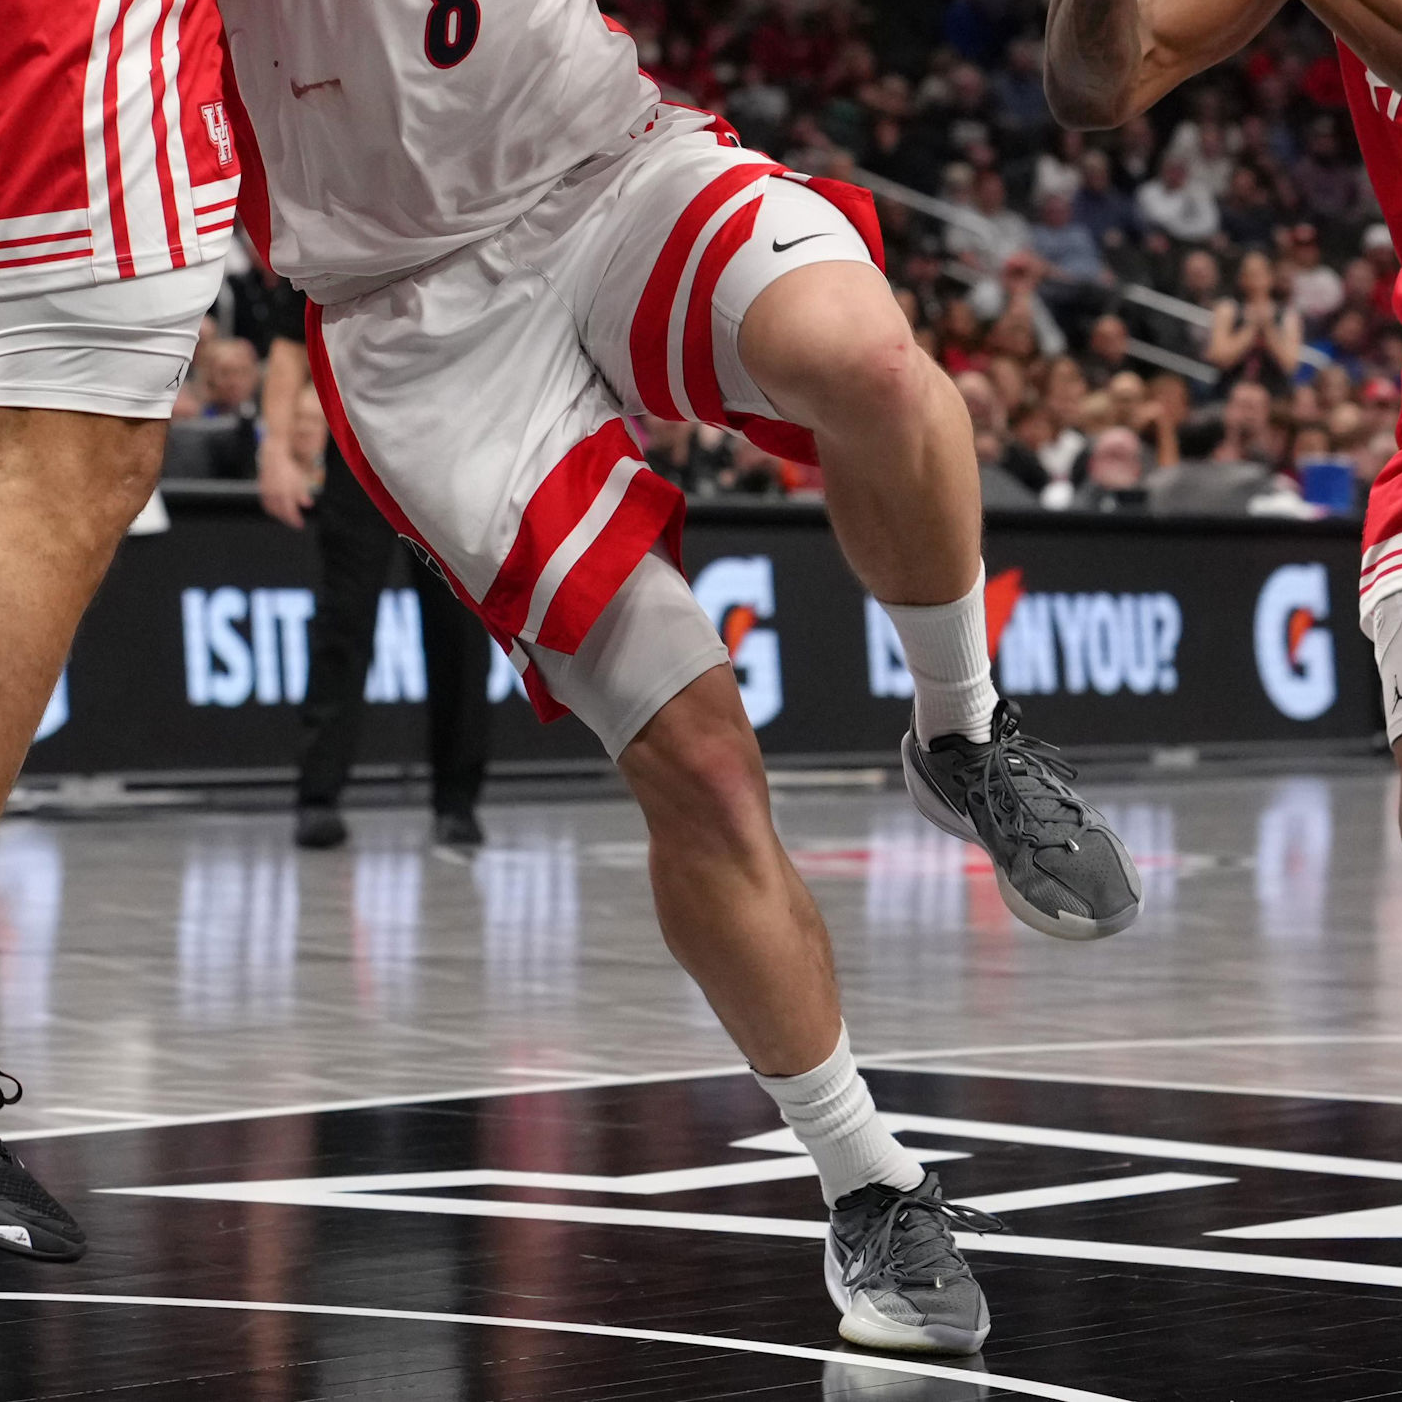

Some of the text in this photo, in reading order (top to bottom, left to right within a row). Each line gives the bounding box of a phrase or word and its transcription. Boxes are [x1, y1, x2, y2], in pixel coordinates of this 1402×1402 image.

[690, 555, 785, 730] G
[1055, 591, 1183, 697] YOU?
[1254, 562, 1338, 721] G
